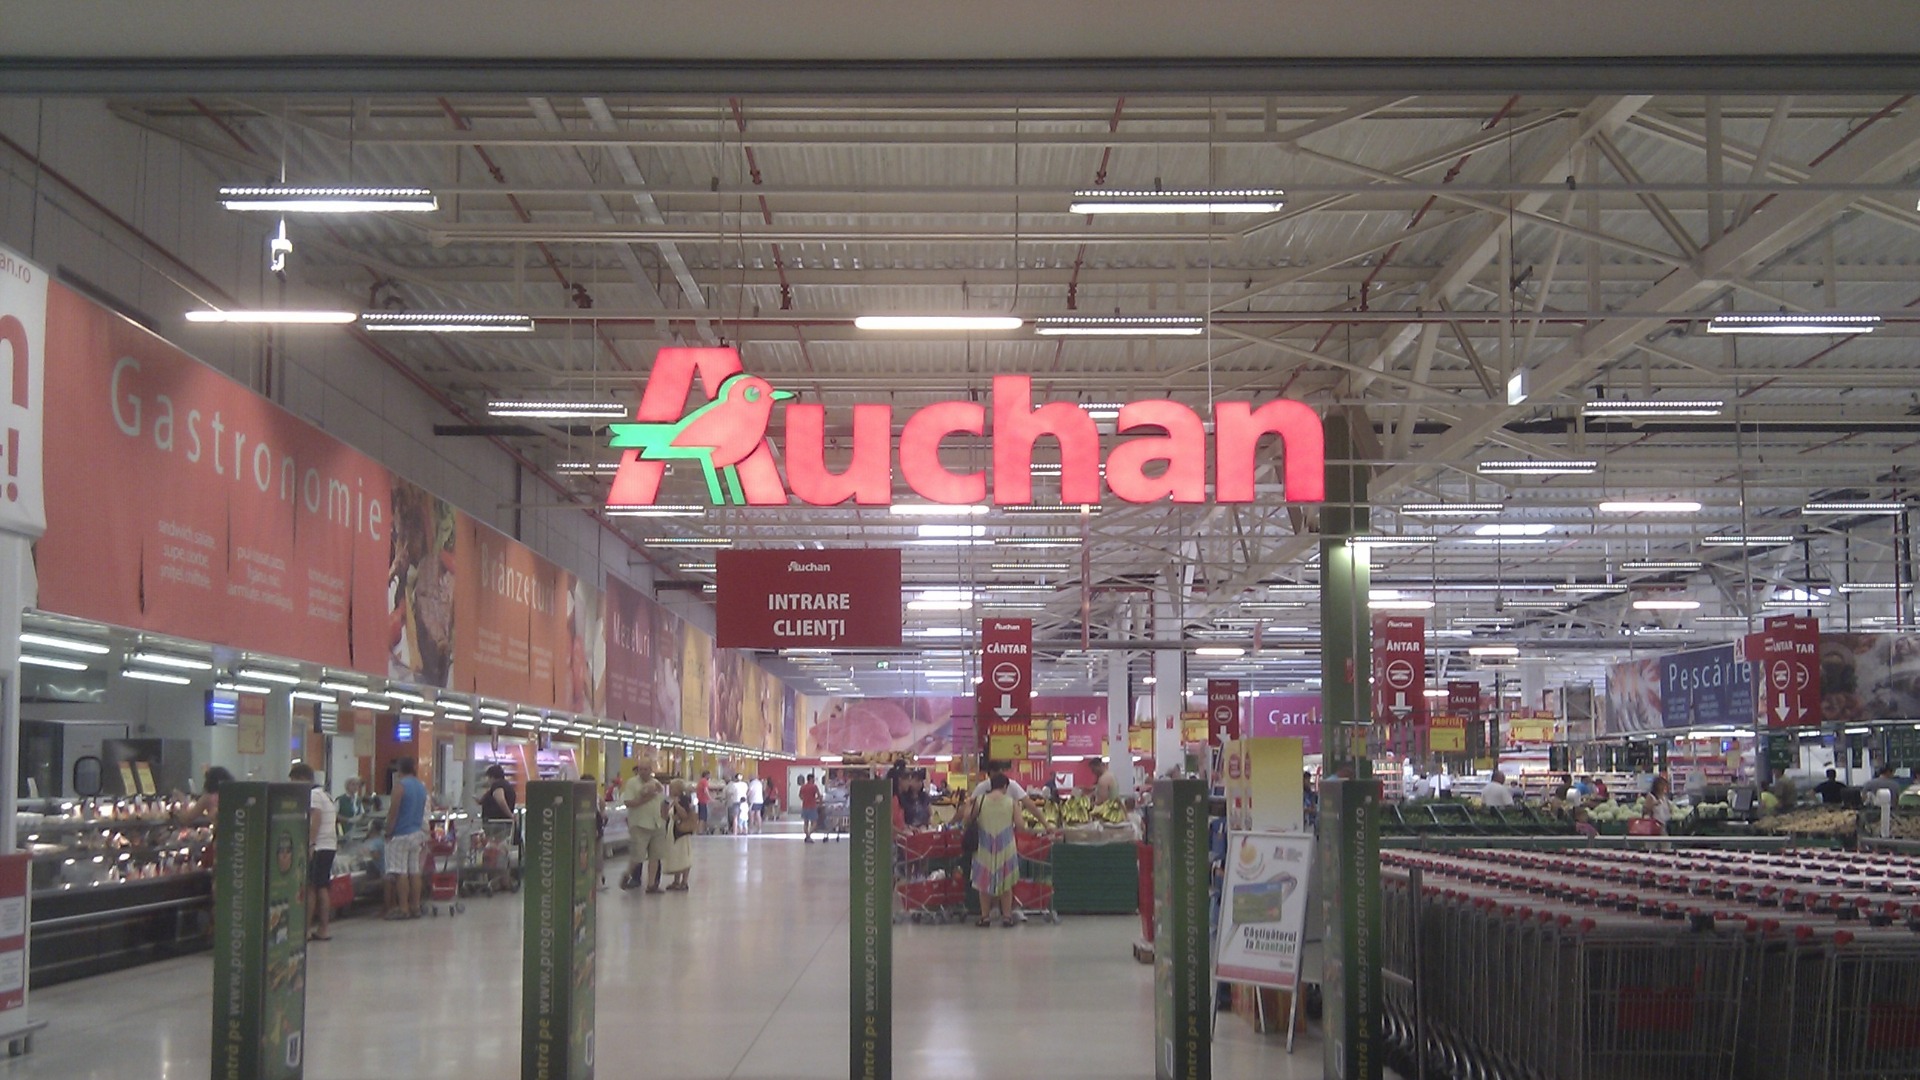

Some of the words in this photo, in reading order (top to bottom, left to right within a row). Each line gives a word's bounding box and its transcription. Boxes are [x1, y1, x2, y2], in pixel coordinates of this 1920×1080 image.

[605, 346, 1326, 506] Auchan
[110, 355, 383, 541] Gastronomie
[787, 561, 831, 572] Auchan
[768, 593, 850, 610] INTRARE
[986, 642, 1027, 654] CÂNTAR
[1386, 639, 1420, 652] ÂNTAR
[1013, 744, 1022, 756] 3
[228, 808, 246, 1016] www.program.activia.ro
[539, 807, 554, 1015] www.program.activia.ro
[865, 805, 878, 1013] www.program.activia.ro
[1185, 805, 1198, 1013] www.program.activia.ro
[1355, 806, 1370, 1015] www.program.activia.ro
[227, 1019, 242, 1041] pe
[538, 1018, 553, 1039] pe
[864, 1016, 878, 1038] pe
[1187, 1016, 1199, 1037] pe
[1358, 1018, 1371, 1040] pe
